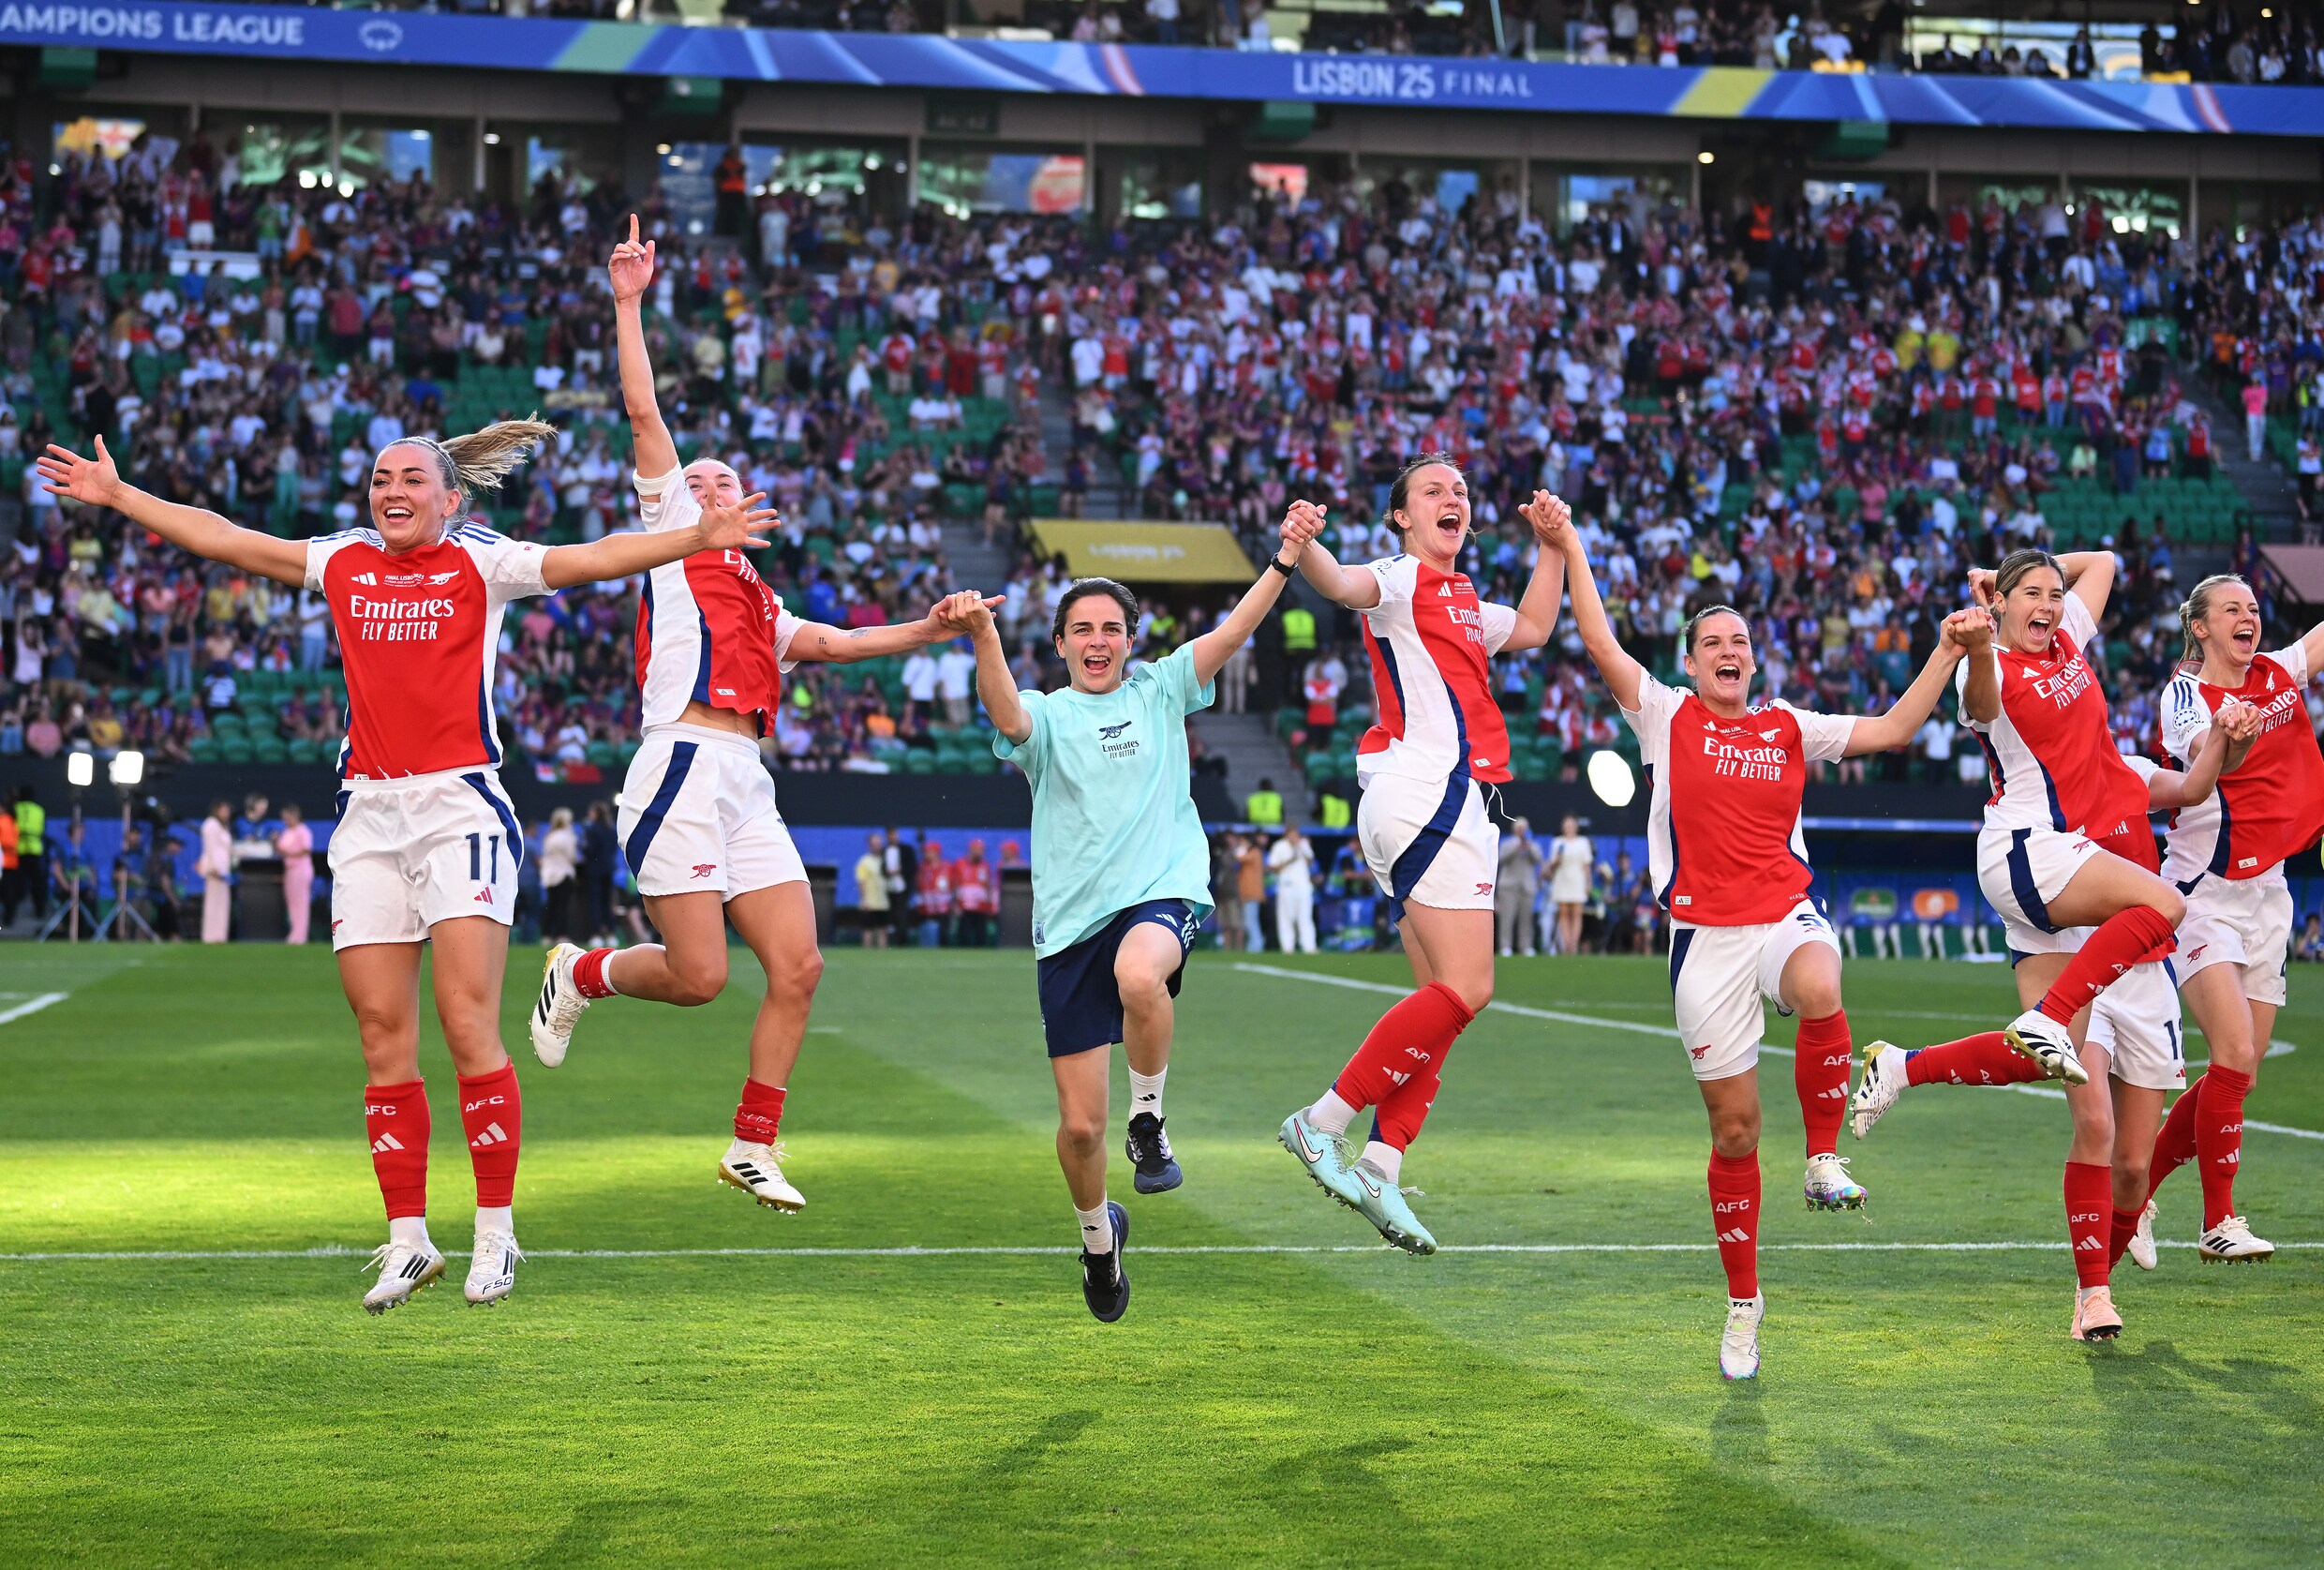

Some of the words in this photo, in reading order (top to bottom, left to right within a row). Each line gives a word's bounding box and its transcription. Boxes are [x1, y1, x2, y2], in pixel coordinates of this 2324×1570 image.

[173, 13, 305, 46] LEAGUE
[1292, 59, 1395, 97] LISBON
[1398, 64, 1436, 99] 25
[1443, 69, 1533, 98] FINAL
[350, 594, 454, 619] Emirates
[362, 621, 384, 640] FLY
[387, 621, 439, 641] BETTER
[2053, 690, 2071, 710] FLY
[2065, 670, 2092, 699] BETTER
[2265, 708, 2294, 733] BETTER
[1102, 740, 1140, 752] Emirates
[1118, 749, 1136, 758] BETTER
[1715, 758, 1738, 776] FLY
[1740, 761, 1780, 782] BETTER
[465, 831, 500, 885] 11
[365, 1105, 396, 1116] AFC
[465, 1095, 504, 1114] AFC
[1716, 1199, 1750, 1214] AFC
[2071, 1212, 2100, 1223] AFC
[482, 1276, 513, 1294] F50
